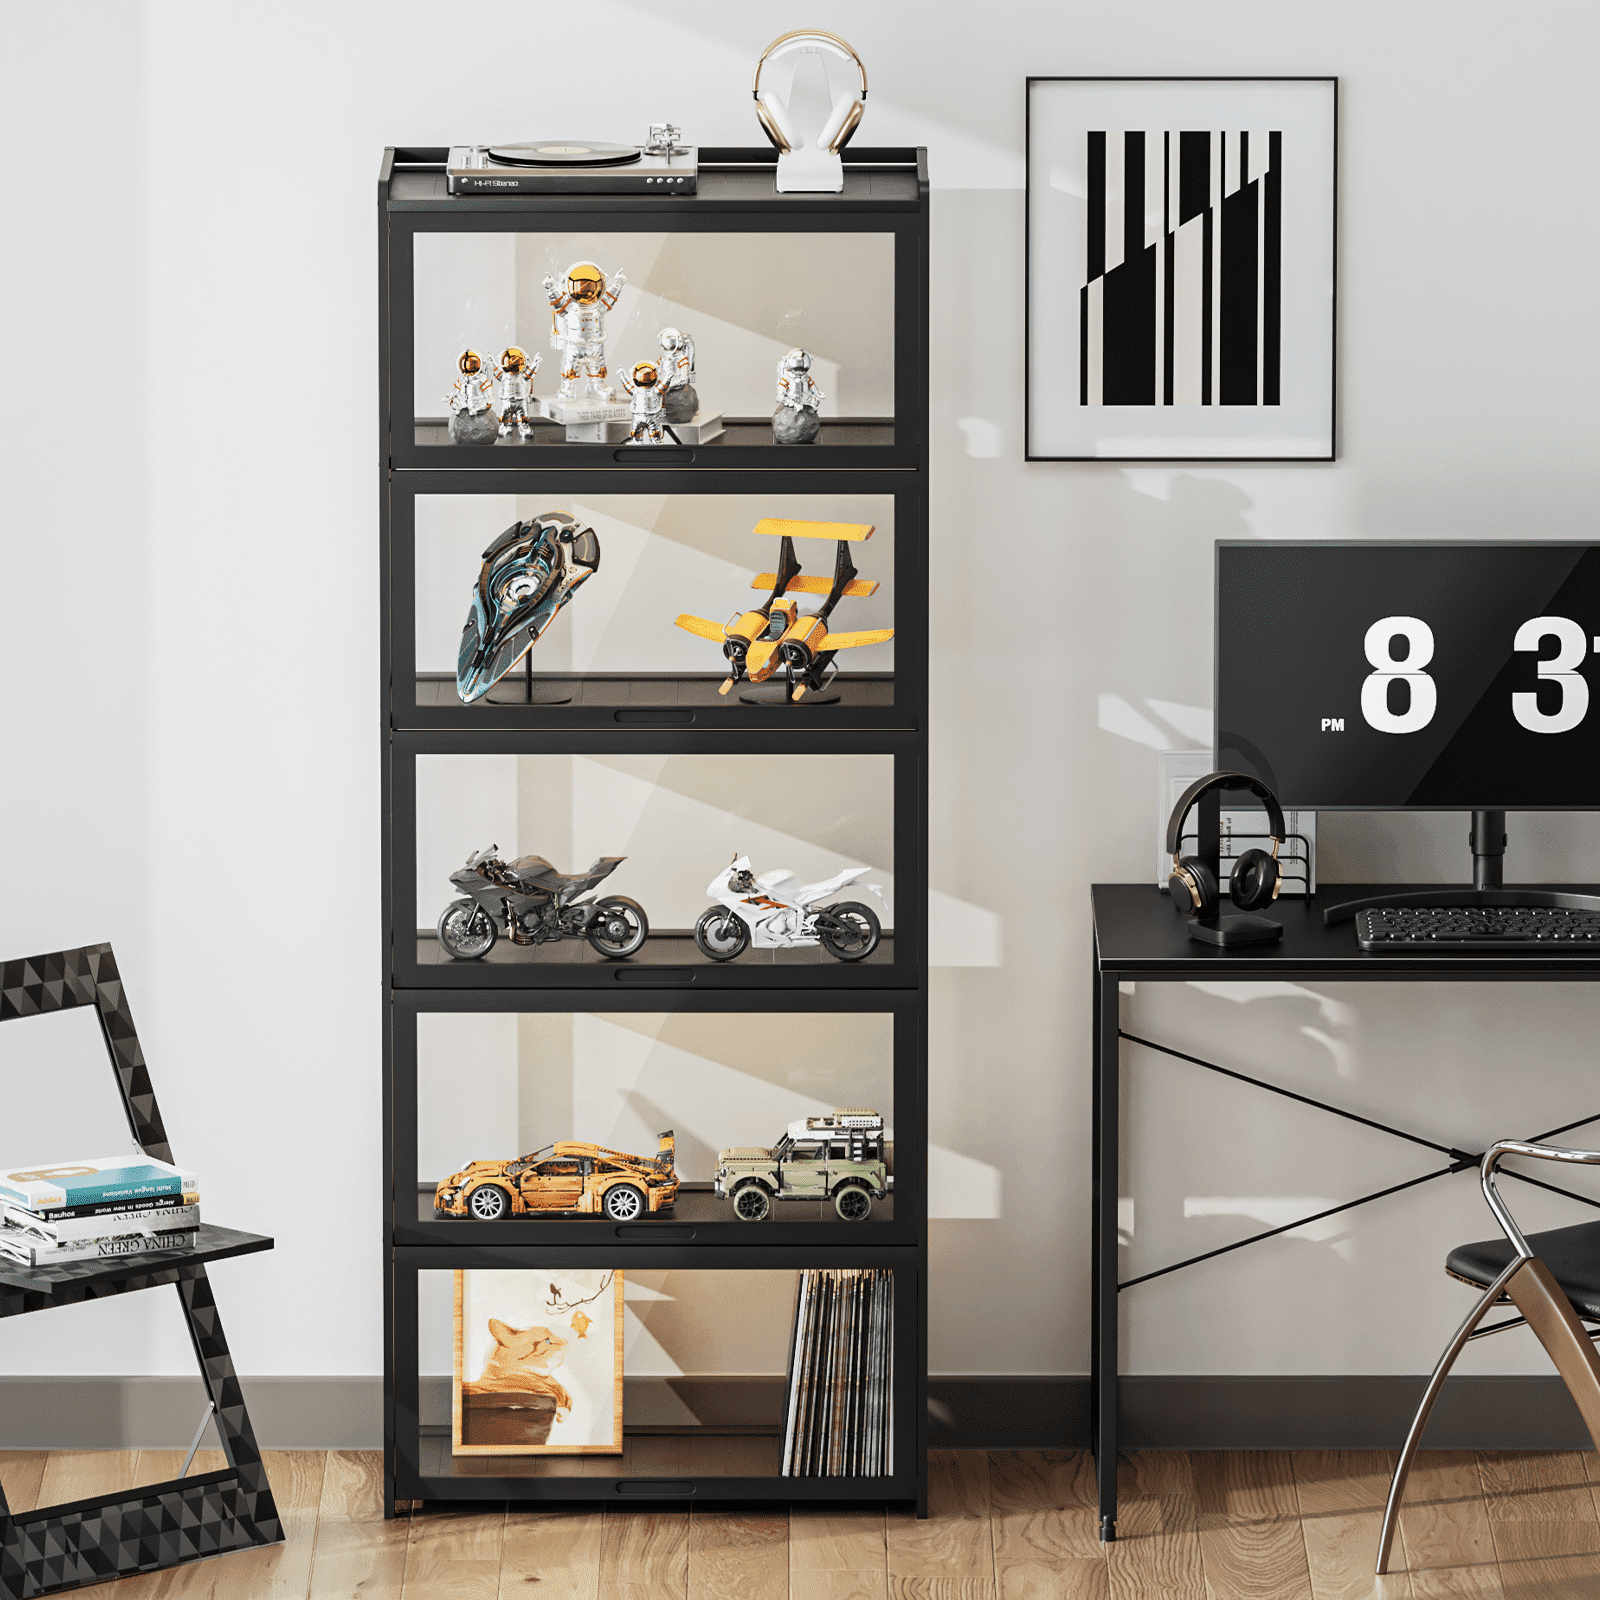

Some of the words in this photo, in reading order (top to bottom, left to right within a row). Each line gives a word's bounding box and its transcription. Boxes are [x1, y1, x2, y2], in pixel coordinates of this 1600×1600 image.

[1321, 718, 1345, 731] PM
[1360, 616, 1437, 734] 8
[1512, 616, 1600, 734] 3
[37, 1197, 62, 1205] Addict
[48, 1210, 76, 1219] Bauhos
[98, 1239, 140, 1256] GREEN
[143, 1234, 186, 1250] CHINA
